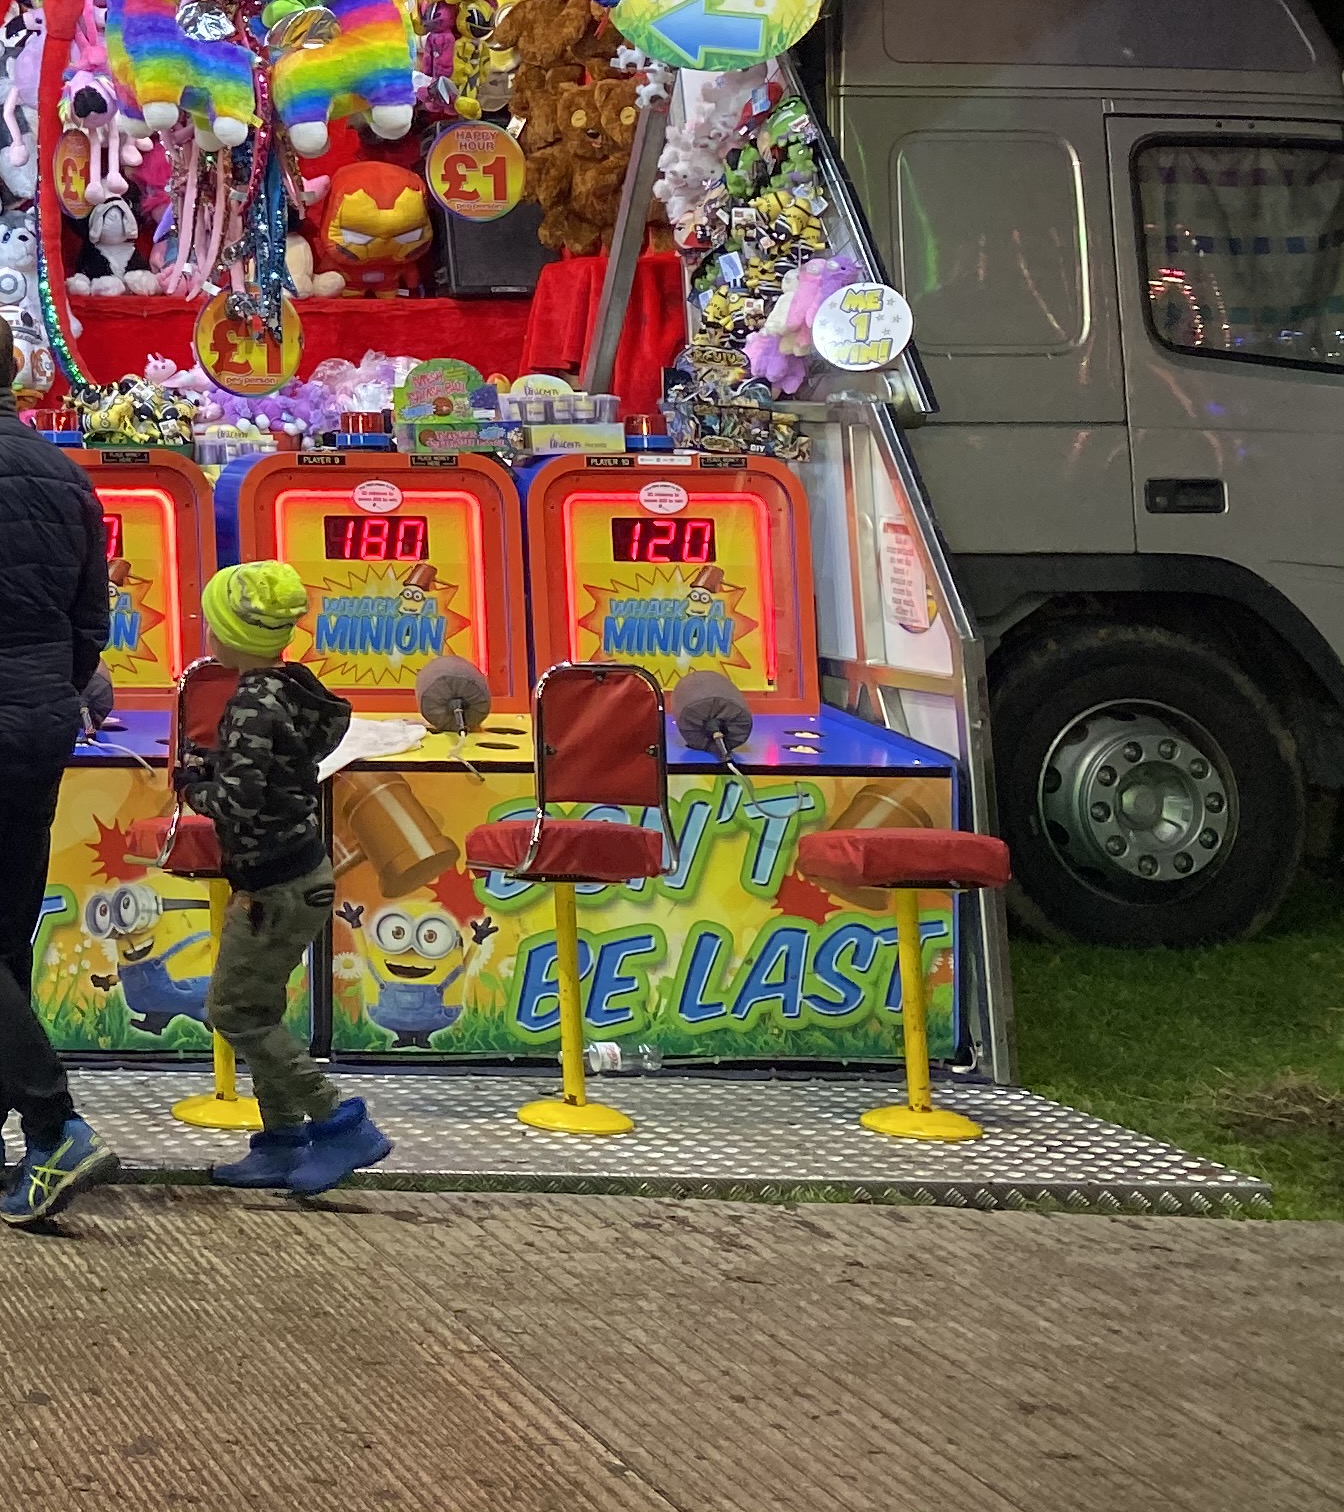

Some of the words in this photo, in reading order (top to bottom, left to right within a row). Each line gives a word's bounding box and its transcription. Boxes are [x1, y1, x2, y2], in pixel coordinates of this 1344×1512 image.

[456, 130, 498, 141] HAPPY
[459, 141, 496, 151] HOUR
[441, 153, 508, 202] £1
[840, 288, 885, 313] ME
[849, 312, 872, 342] 1
[210, 318, 282, 376] £1
[824, 338, 894, 365] WIN!
[303, 456, 331, 464] PLAYER
[749, 443, 765, 453] DIY
[590, 458, 619, 466] PLAYER
[344, 519, 425, 561] 180
[630, 520, 711, 563] 120
[116, 592, 133, 612] A
[322, 596, 402, 615] WHACK
[421, 597, 438, 615] A
[610, 598, 689, 618] WHACK
[708, 599, 725, 617] A
[316, 614, 447, 655] MINION
[603, 616, 734, 657] MINION
[516, 934, 656, 1032] BE
[678, 920, 949, 1020] LAST
